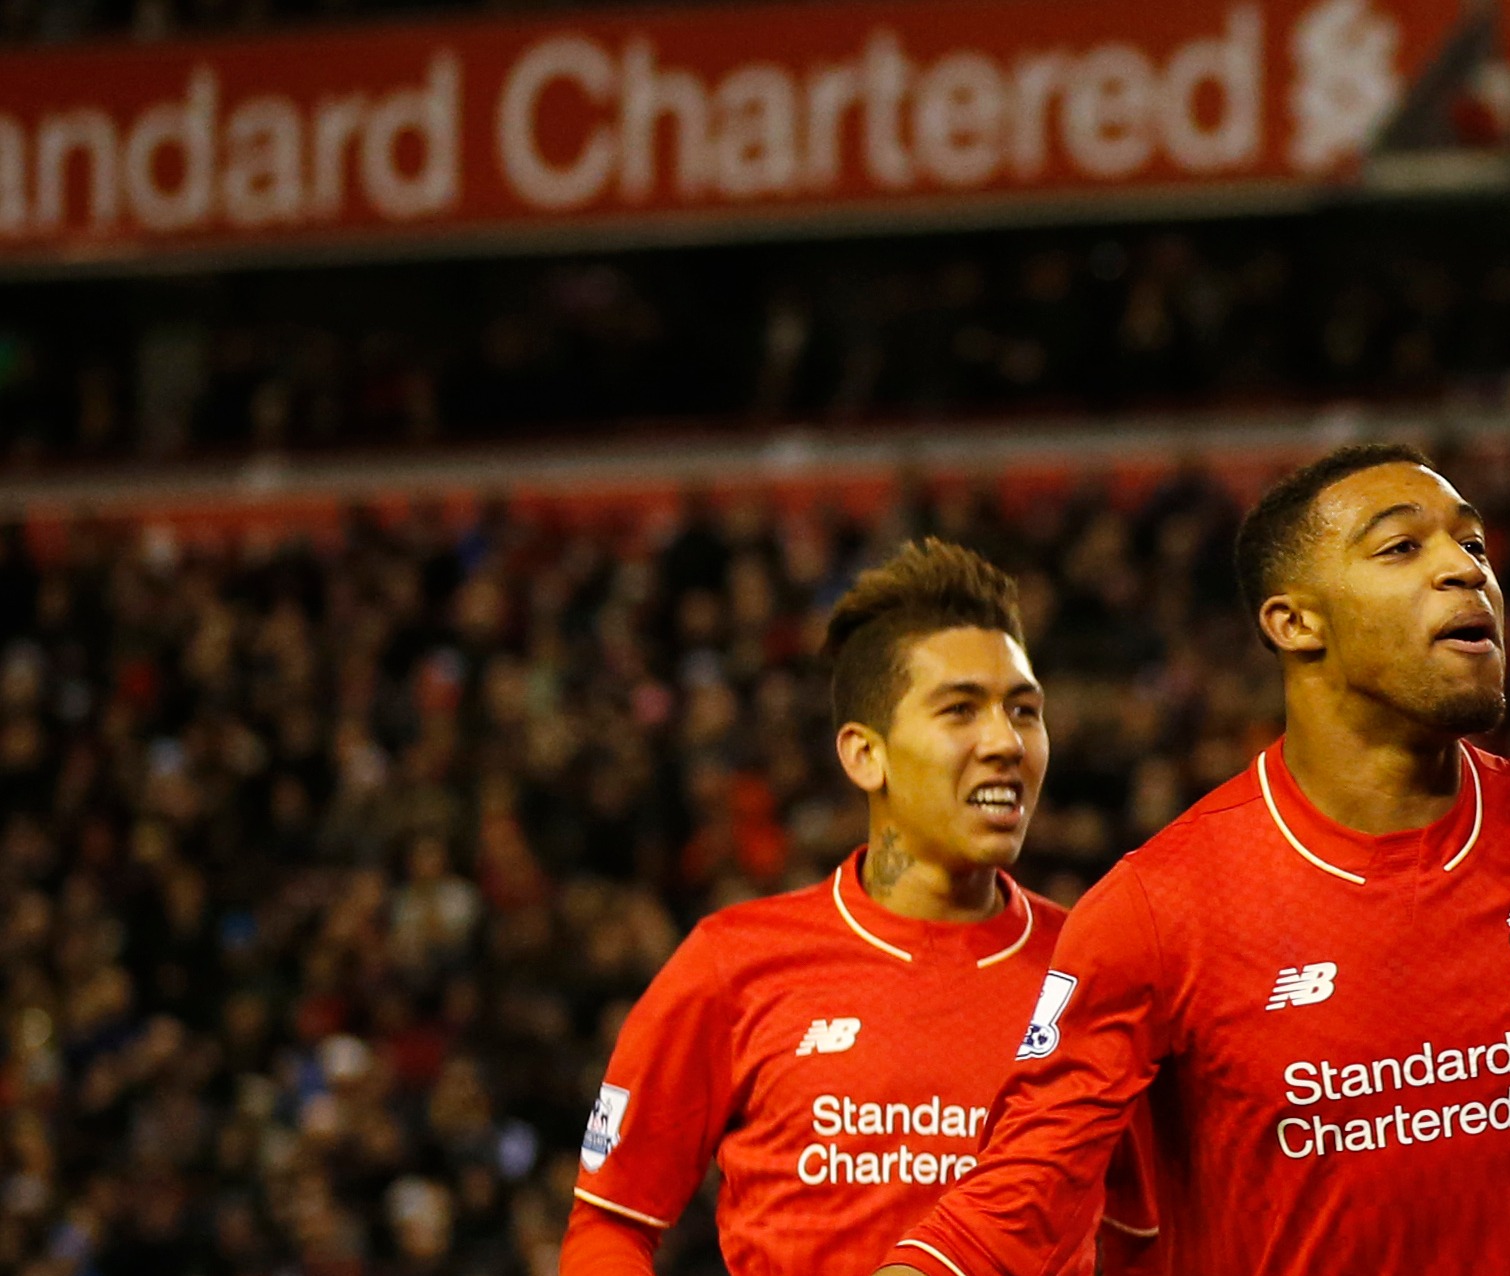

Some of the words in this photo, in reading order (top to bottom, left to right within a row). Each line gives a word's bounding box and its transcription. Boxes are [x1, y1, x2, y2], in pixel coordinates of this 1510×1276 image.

[0, 62, 462, 238] ndard
[496, 8, 1266, 210] Chartered
[1266, 962, 1337, 1010] NB
[795, 1017, 862, 1056] NB
[812, 1094, 990, 1138] Standar
